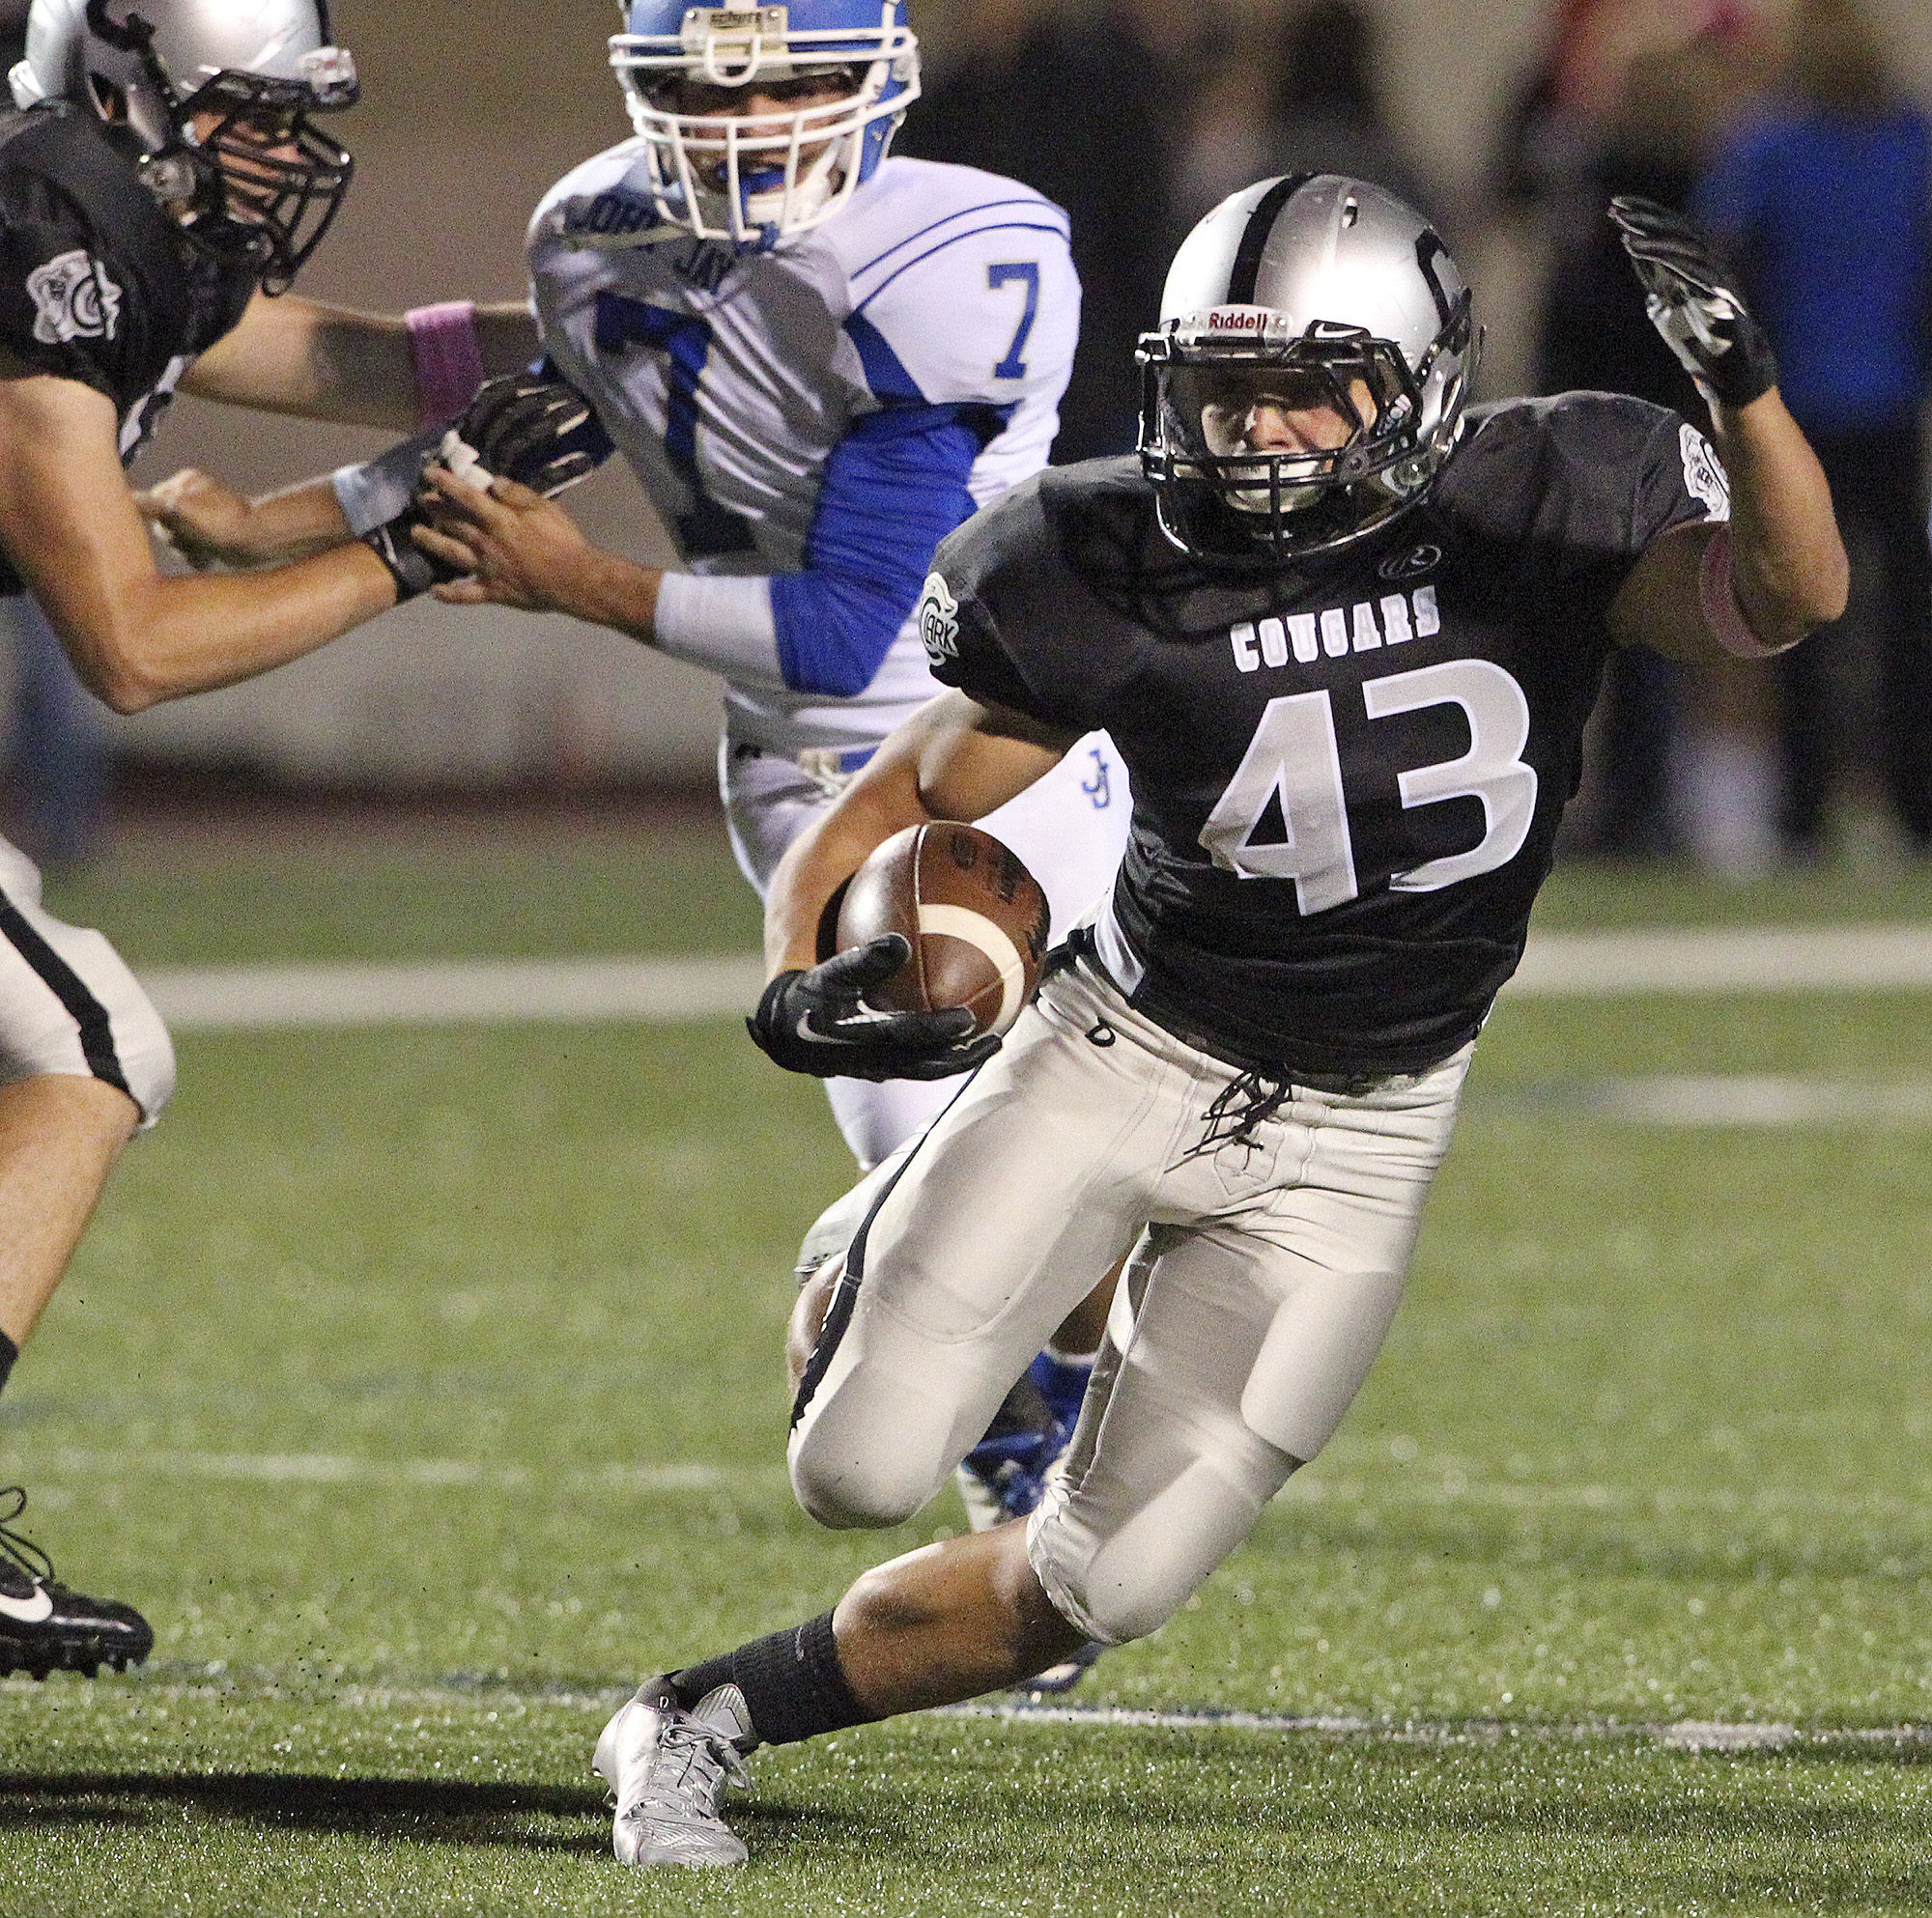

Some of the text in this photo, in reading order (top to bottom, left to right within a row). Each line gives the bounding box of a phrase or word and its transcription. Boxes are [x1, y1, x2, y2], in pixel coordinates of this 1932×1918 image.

[987, 262, 1040, 380] 7
[1208, 312, 1268, 330] Riddell
[1230, 584, 1441, 673] COUGARS
[1198, 659, 1538, 917] 43
